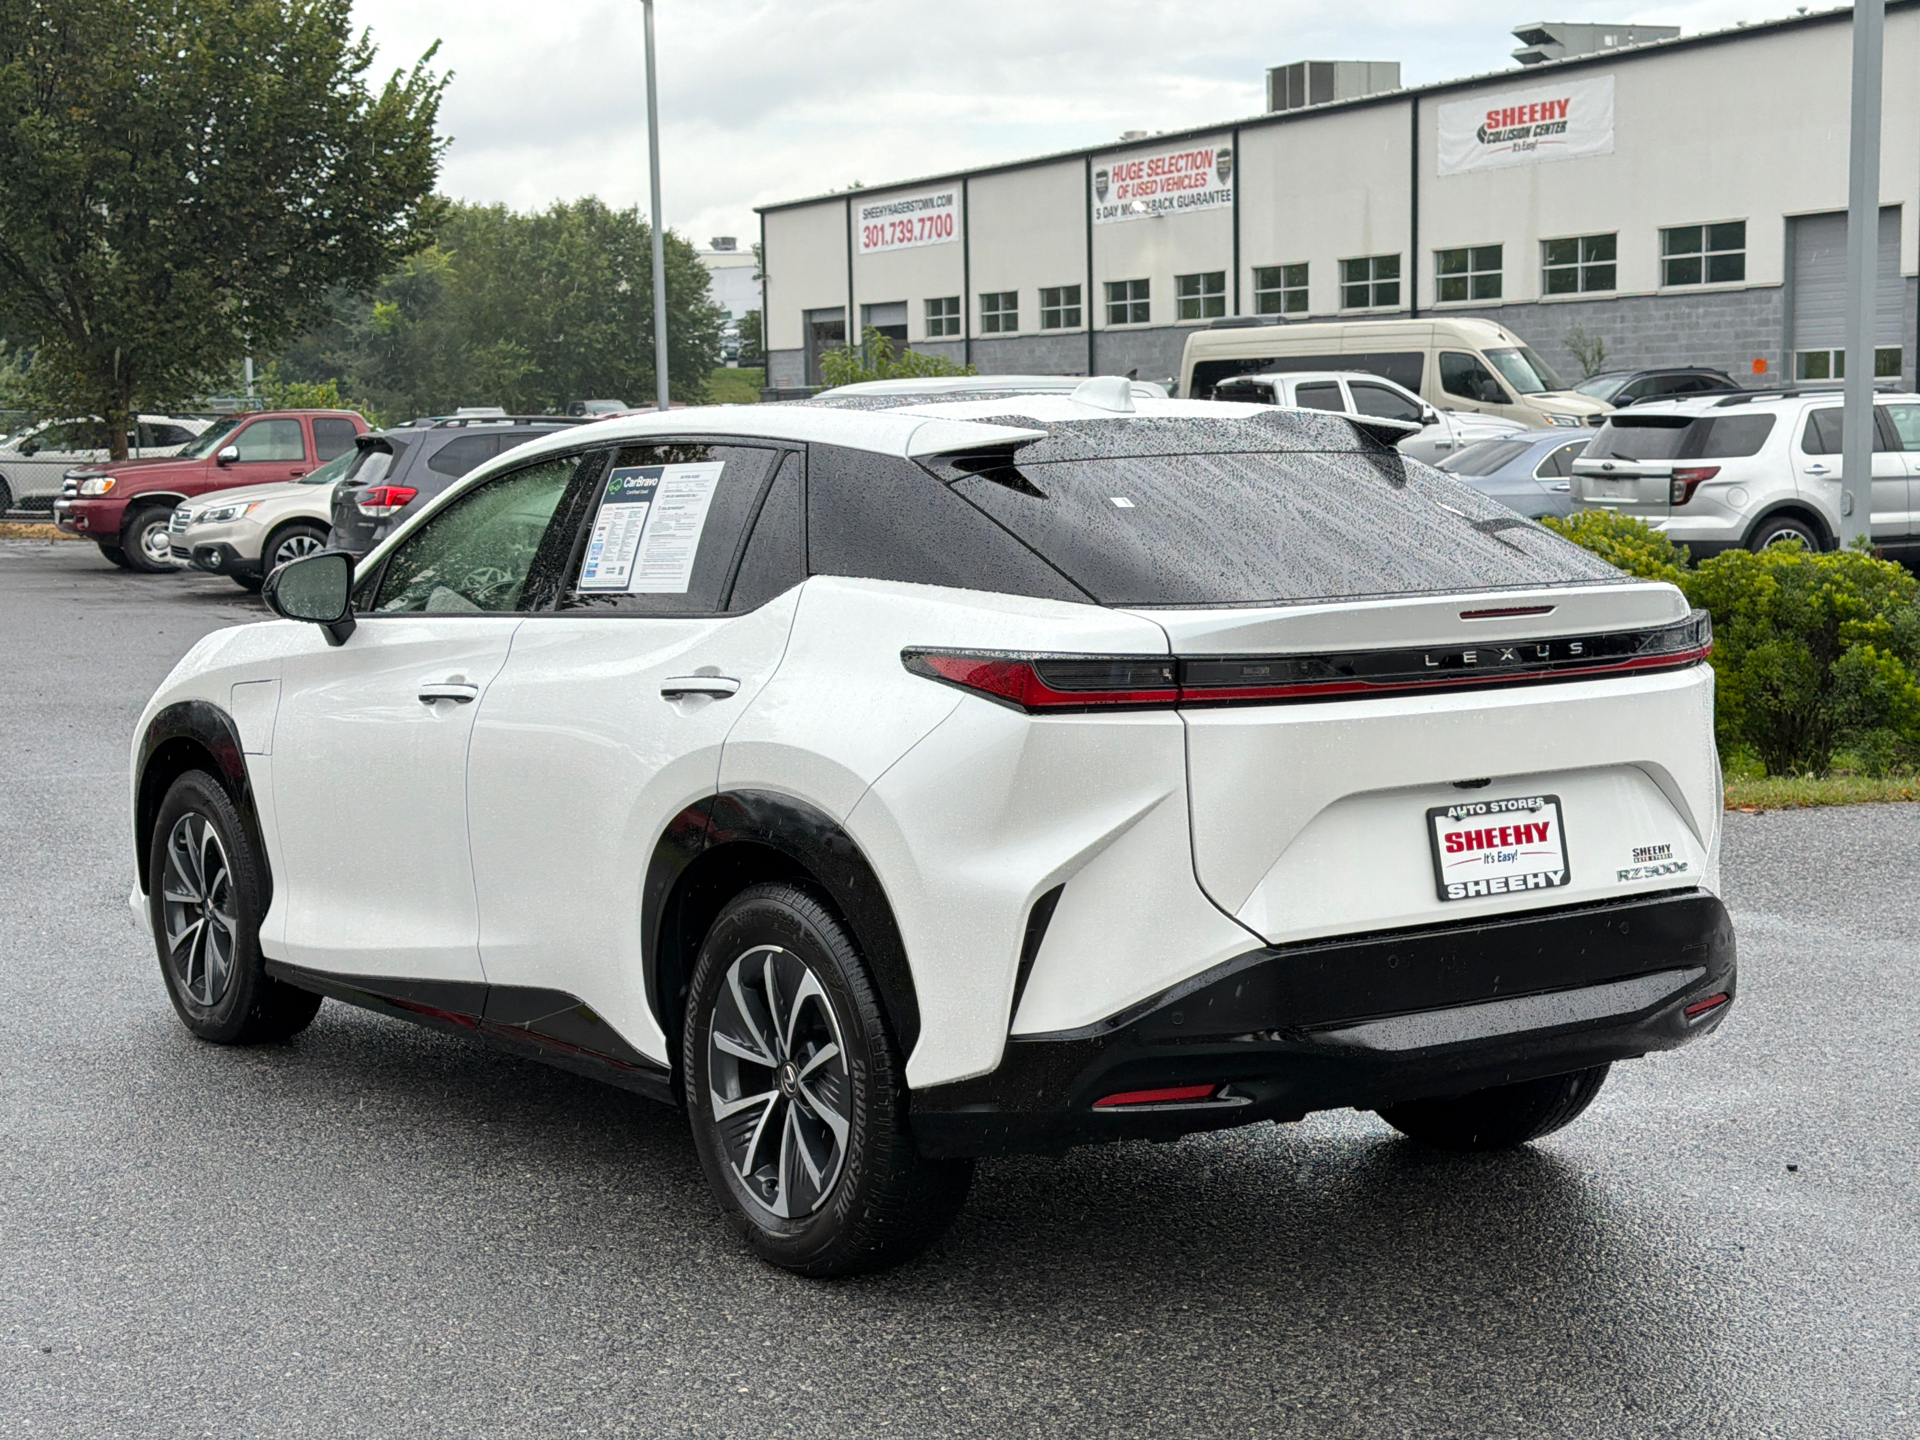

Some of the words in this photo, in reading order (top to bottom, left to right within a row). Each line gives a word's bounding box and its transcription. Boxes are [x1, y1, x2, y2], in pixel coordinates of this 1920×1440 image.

[1486, 98, 1571, 130] SHEEHY
[1486, 126, 1532, 144] COLLISION
[1533, 120, 1568, 138] CENTER
[1112, 160, 1145, 183] HUGE
[1146, 149, 1214, 178] SELECTION
[1117, 183, 1130, 200] OF
[1131, 179, 1158, 198] USED
[1159, 171, 1208, 193] VEHICLES
[862, 193, 954, 221] SHEEHYHAGERSTOWN.COM
[1096, 207, 1102, 220] 5
[1103, 205, 1119, 219] DAY
[1177, 188, 1232, 208] GUARANTEE
[863, 212, 954, 249] 301.739.7700
[623, 475, 659, 488] CarBravo
[1424, 642, 1584, 667] LEXUS
[1447, 803, 1487, 818] AUTO
[1490, 797, 1546, 813] STORES
[1444, 821, 1551, 855] SHEEHY
[1632, 843, 1672, 858] SHEEHY
[1483, 851, 1497, 864] It's
[1497, 849, 1518, 864] Easy!
[1447, 871, 1565, 899] SHEEHY
[834, 1058, 867, 1225] BRIDGESTONE
